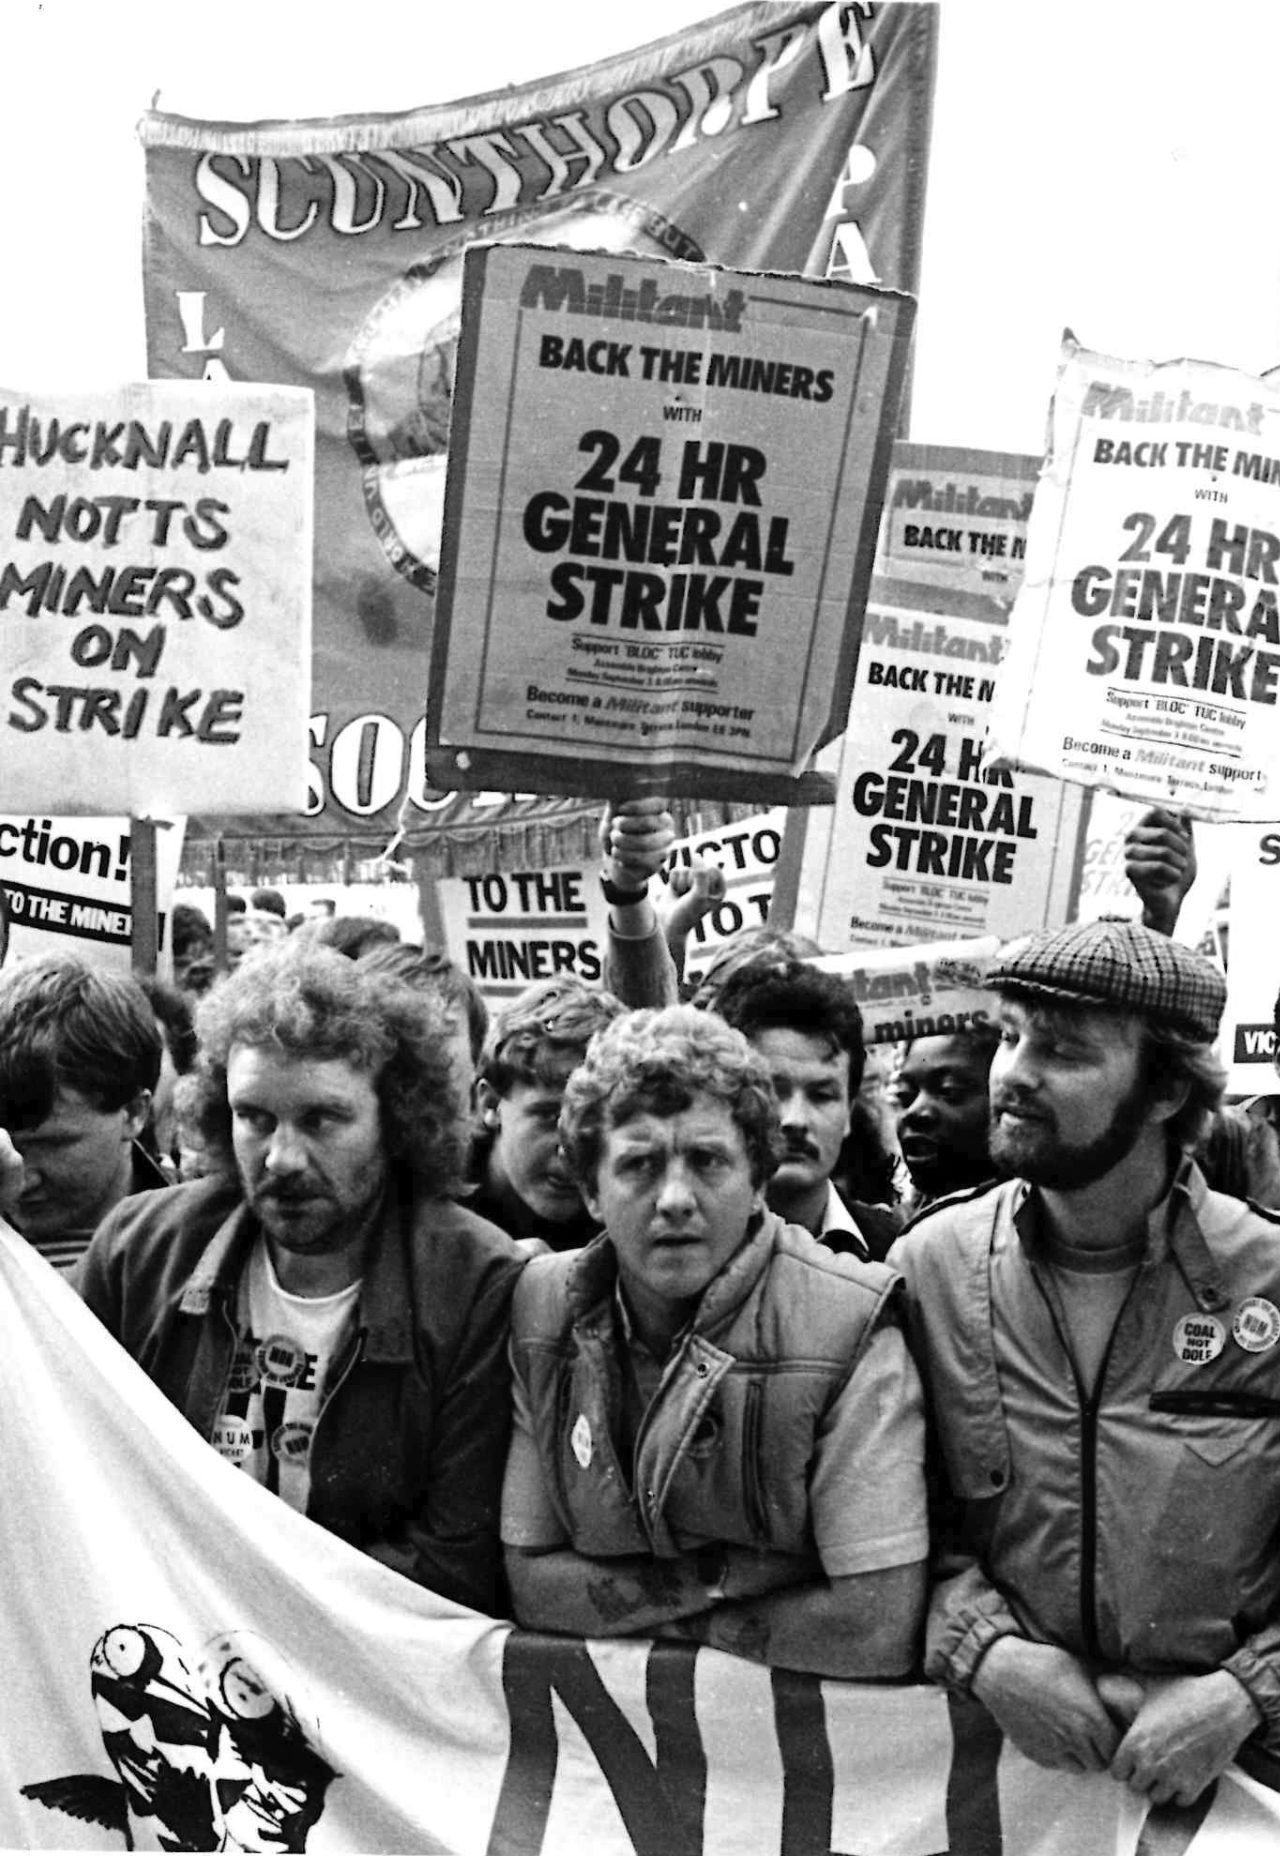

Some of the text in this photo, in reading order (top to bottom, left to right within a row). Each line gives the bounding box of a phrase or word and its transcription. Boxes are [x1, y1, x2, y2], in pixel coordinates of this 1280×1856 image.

[195, 0, 874, 247] SCUNTHORPE
[520, 264, 746, 333] Militant
[539, 335, 835, 403] BACK THE MINERS
[663, 406, 702, 423] WITH
[1081, 380, 1266, 437] Militant
[0, 404, 290, 474] HUCKNALL
[1093, 438, 1168, 468] BACK
[1175, 441, 1229, 473] THE
[574, 429, 767, 507] 24 HR
[893, 478, 1036, 522] Militant
[1195, 489, 1229, 504] WITH
[15, 494, 231, 551] NOTTS
[522, 490, 795, 576] GENERAL
[904, 525, 964, 552] BACK
[968, 531, 1009, 558] THE
[1118, 512, 1191, 566] 24
[0, 562, 245, 630] MINERS
[546, 567, 764, 638] STRIKE
[70, 623, 166, 678] ON
[571, 638, 618, 656] Support
[668, 644, 689, 660] TUC
[861, 612, 1003, 666] Militant
[527, 685, 755, 721] Become a Militant supporter
[868, 661, 929, 694] BACK
[933, 671, 975, 699] THE
[8, 677, 245, 744] STRIKE
[948, 712, 975, 726] WITH
[1106, 691, 1149, 709] Support
[1195, 705, 1217, 722] TUC
[1219, 711, 1247, 730] lobby
[888, 728, 947, 778] 24
[1063, 736, 1120, 758] Become
[1122, 749, 1131, 761] a
[1135, 748, 1206, 773] Militant
[852, 772, 1039, 839] GENERAL
[0, 818, 132, 882] ction!
[866, 825, 1018, 885] STRIKE
[28, 895, 70, 924] THE
[462, 870, 587, 914] TO THE
[851, 916, 894, 934] Become
[466, 938, 601, 982] MINERS
[1184, 1323, 1216, 1339] COAL
[1186, 1338, 1211, 1348] NOT
[212, 1430, 251, 1446] NUM
